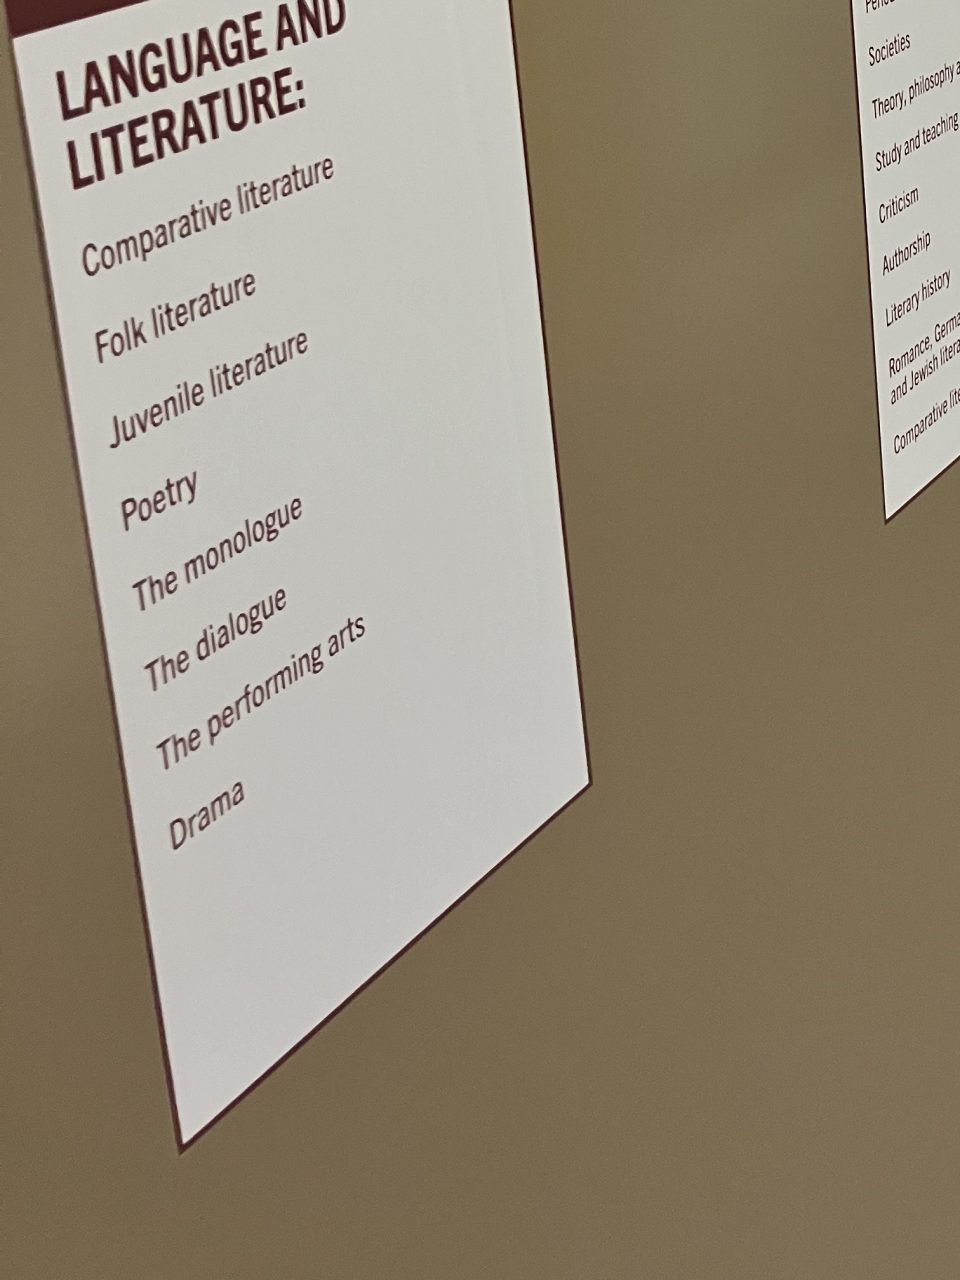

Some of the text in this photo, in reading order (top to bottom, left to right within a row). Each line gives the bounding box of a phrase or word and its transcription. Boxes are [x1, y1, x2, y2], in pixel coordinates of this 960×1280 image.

[55, 11, 267, 121] LANGUAGE
[868, 32, 911, 67] Societies
[872, 88, 907, 120] Theory,
[908, 60, 955, 106] philosophy
[66, 67, 306, 190] LITERATURE:
[875, 110, 959, 172] Study and teaching
[82, 156, 335, 277] Comparative literature
[878, 185, 919, 224] Criticism
[882, 231, 932, 276] Authorship
[95, 271, 257, 363] Folk literature
[885, 269, 951, 327] Literary history
[109, 330, 309, 449] Juvenile literature
[889, 340, 933, 379] Romance,
[890, 379, 908, 405] and
[909, 357, 939, 391] Jewish
[894, 399, 948, 454] Comparative
[121, 471, 198, 531] Poetry
[132, 496, 303, 612] The monologue
[144, 586, 287, 692] The dialogue
[156, 614, 366, 770] The performing arts
[169, 780, 246, 851] Drama
